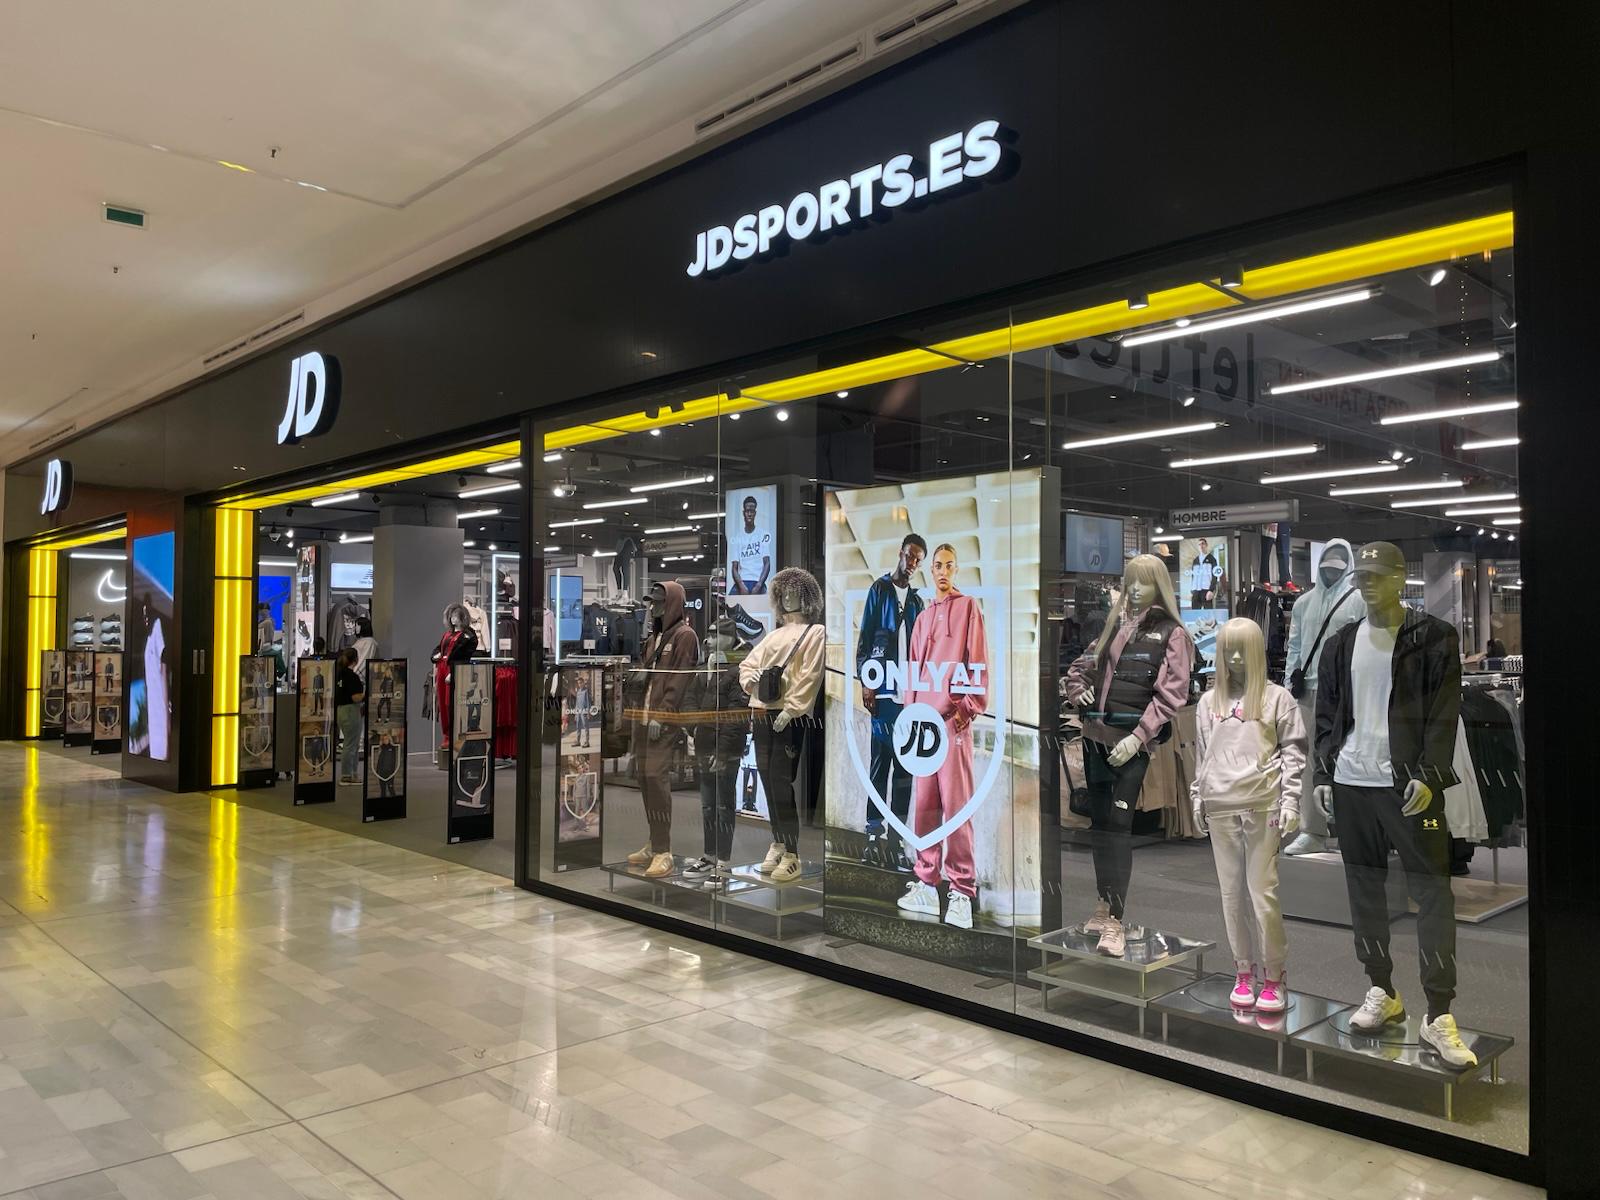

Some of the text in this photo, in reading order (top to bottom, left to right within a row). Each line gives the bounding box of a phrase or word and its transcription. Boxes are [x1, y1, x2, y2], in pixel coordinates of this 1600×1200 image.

[686, 119, 1002, 278] JDSPORTS.ES
[277, 350, 327, 445] JD
[41, 458, 62, 516] JD
[1172, 509, 1228, 524] HOMBRE
[740, 548, 761, 558] MAX
[1090, 554, 1101, 567] JD
[860, 659, 956, 693] ONLY
[900, 720, 942, 758] JD
